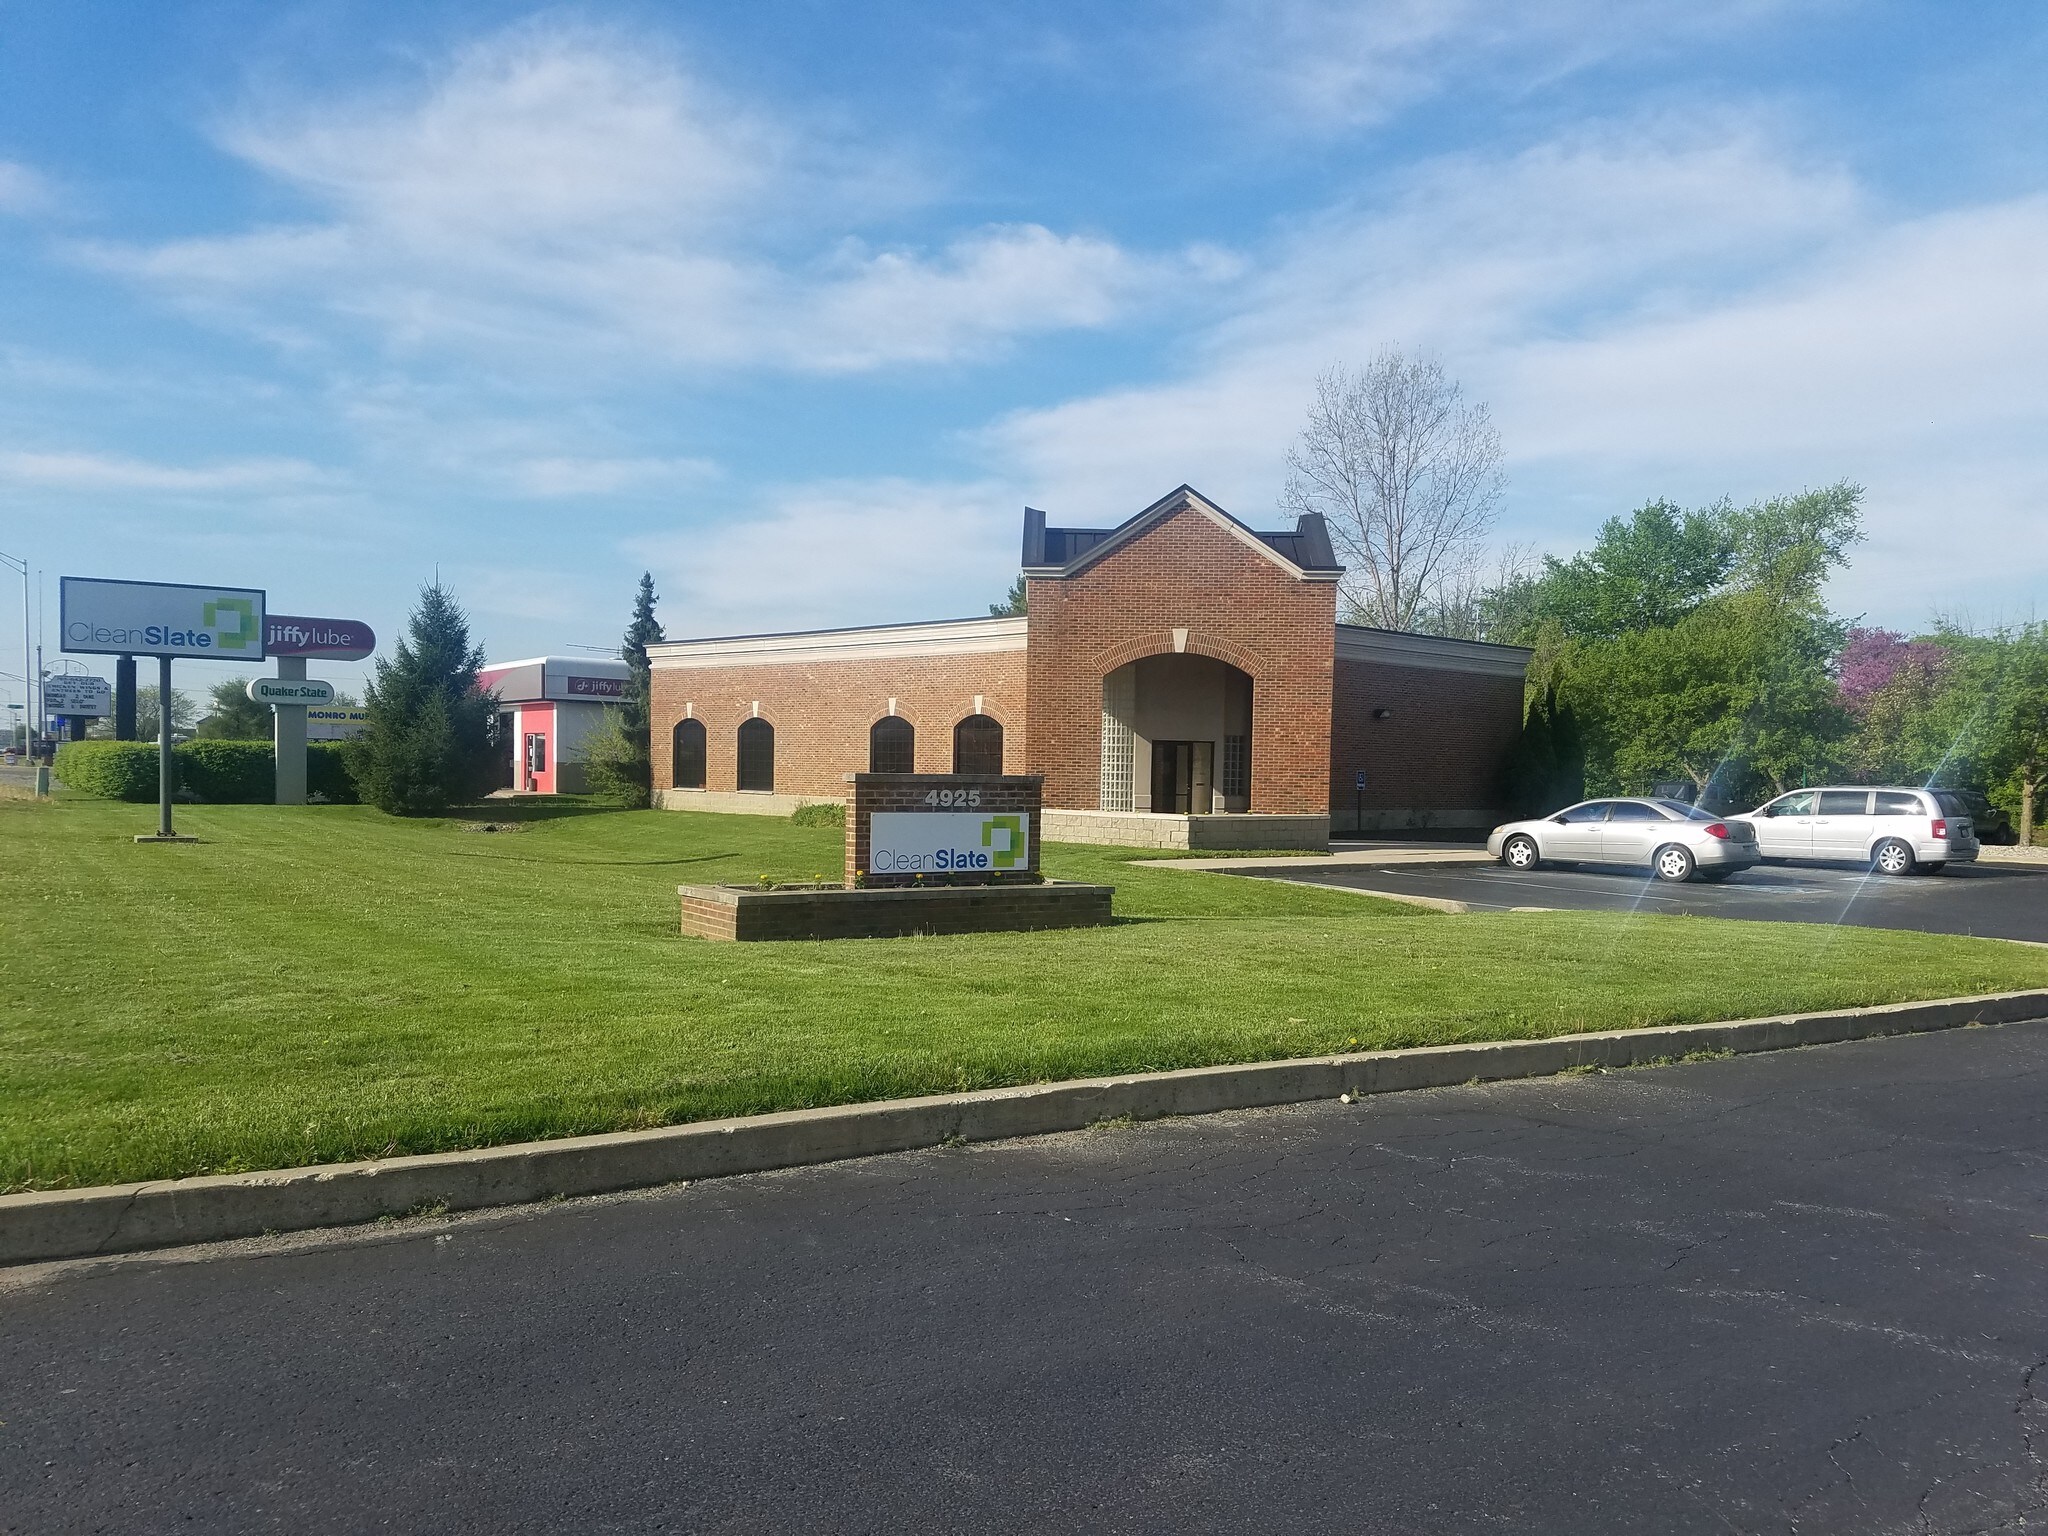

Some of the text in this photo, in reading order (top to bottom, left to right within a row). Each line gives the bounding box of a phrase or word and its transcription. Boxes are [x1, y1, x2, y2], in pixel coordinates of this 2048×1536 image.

[68, 621, 212, 648] CleanSlate
[267, 625, 351, 647] jiffy lube
[260, 685, 328, 698] Quaker State
[591, 681, 612, 693] jiffy
[307, 711, 347, 720] MONRO
[924, 789, 981, 807] 4925
[874, 848, 988, 870] CleanSlate
